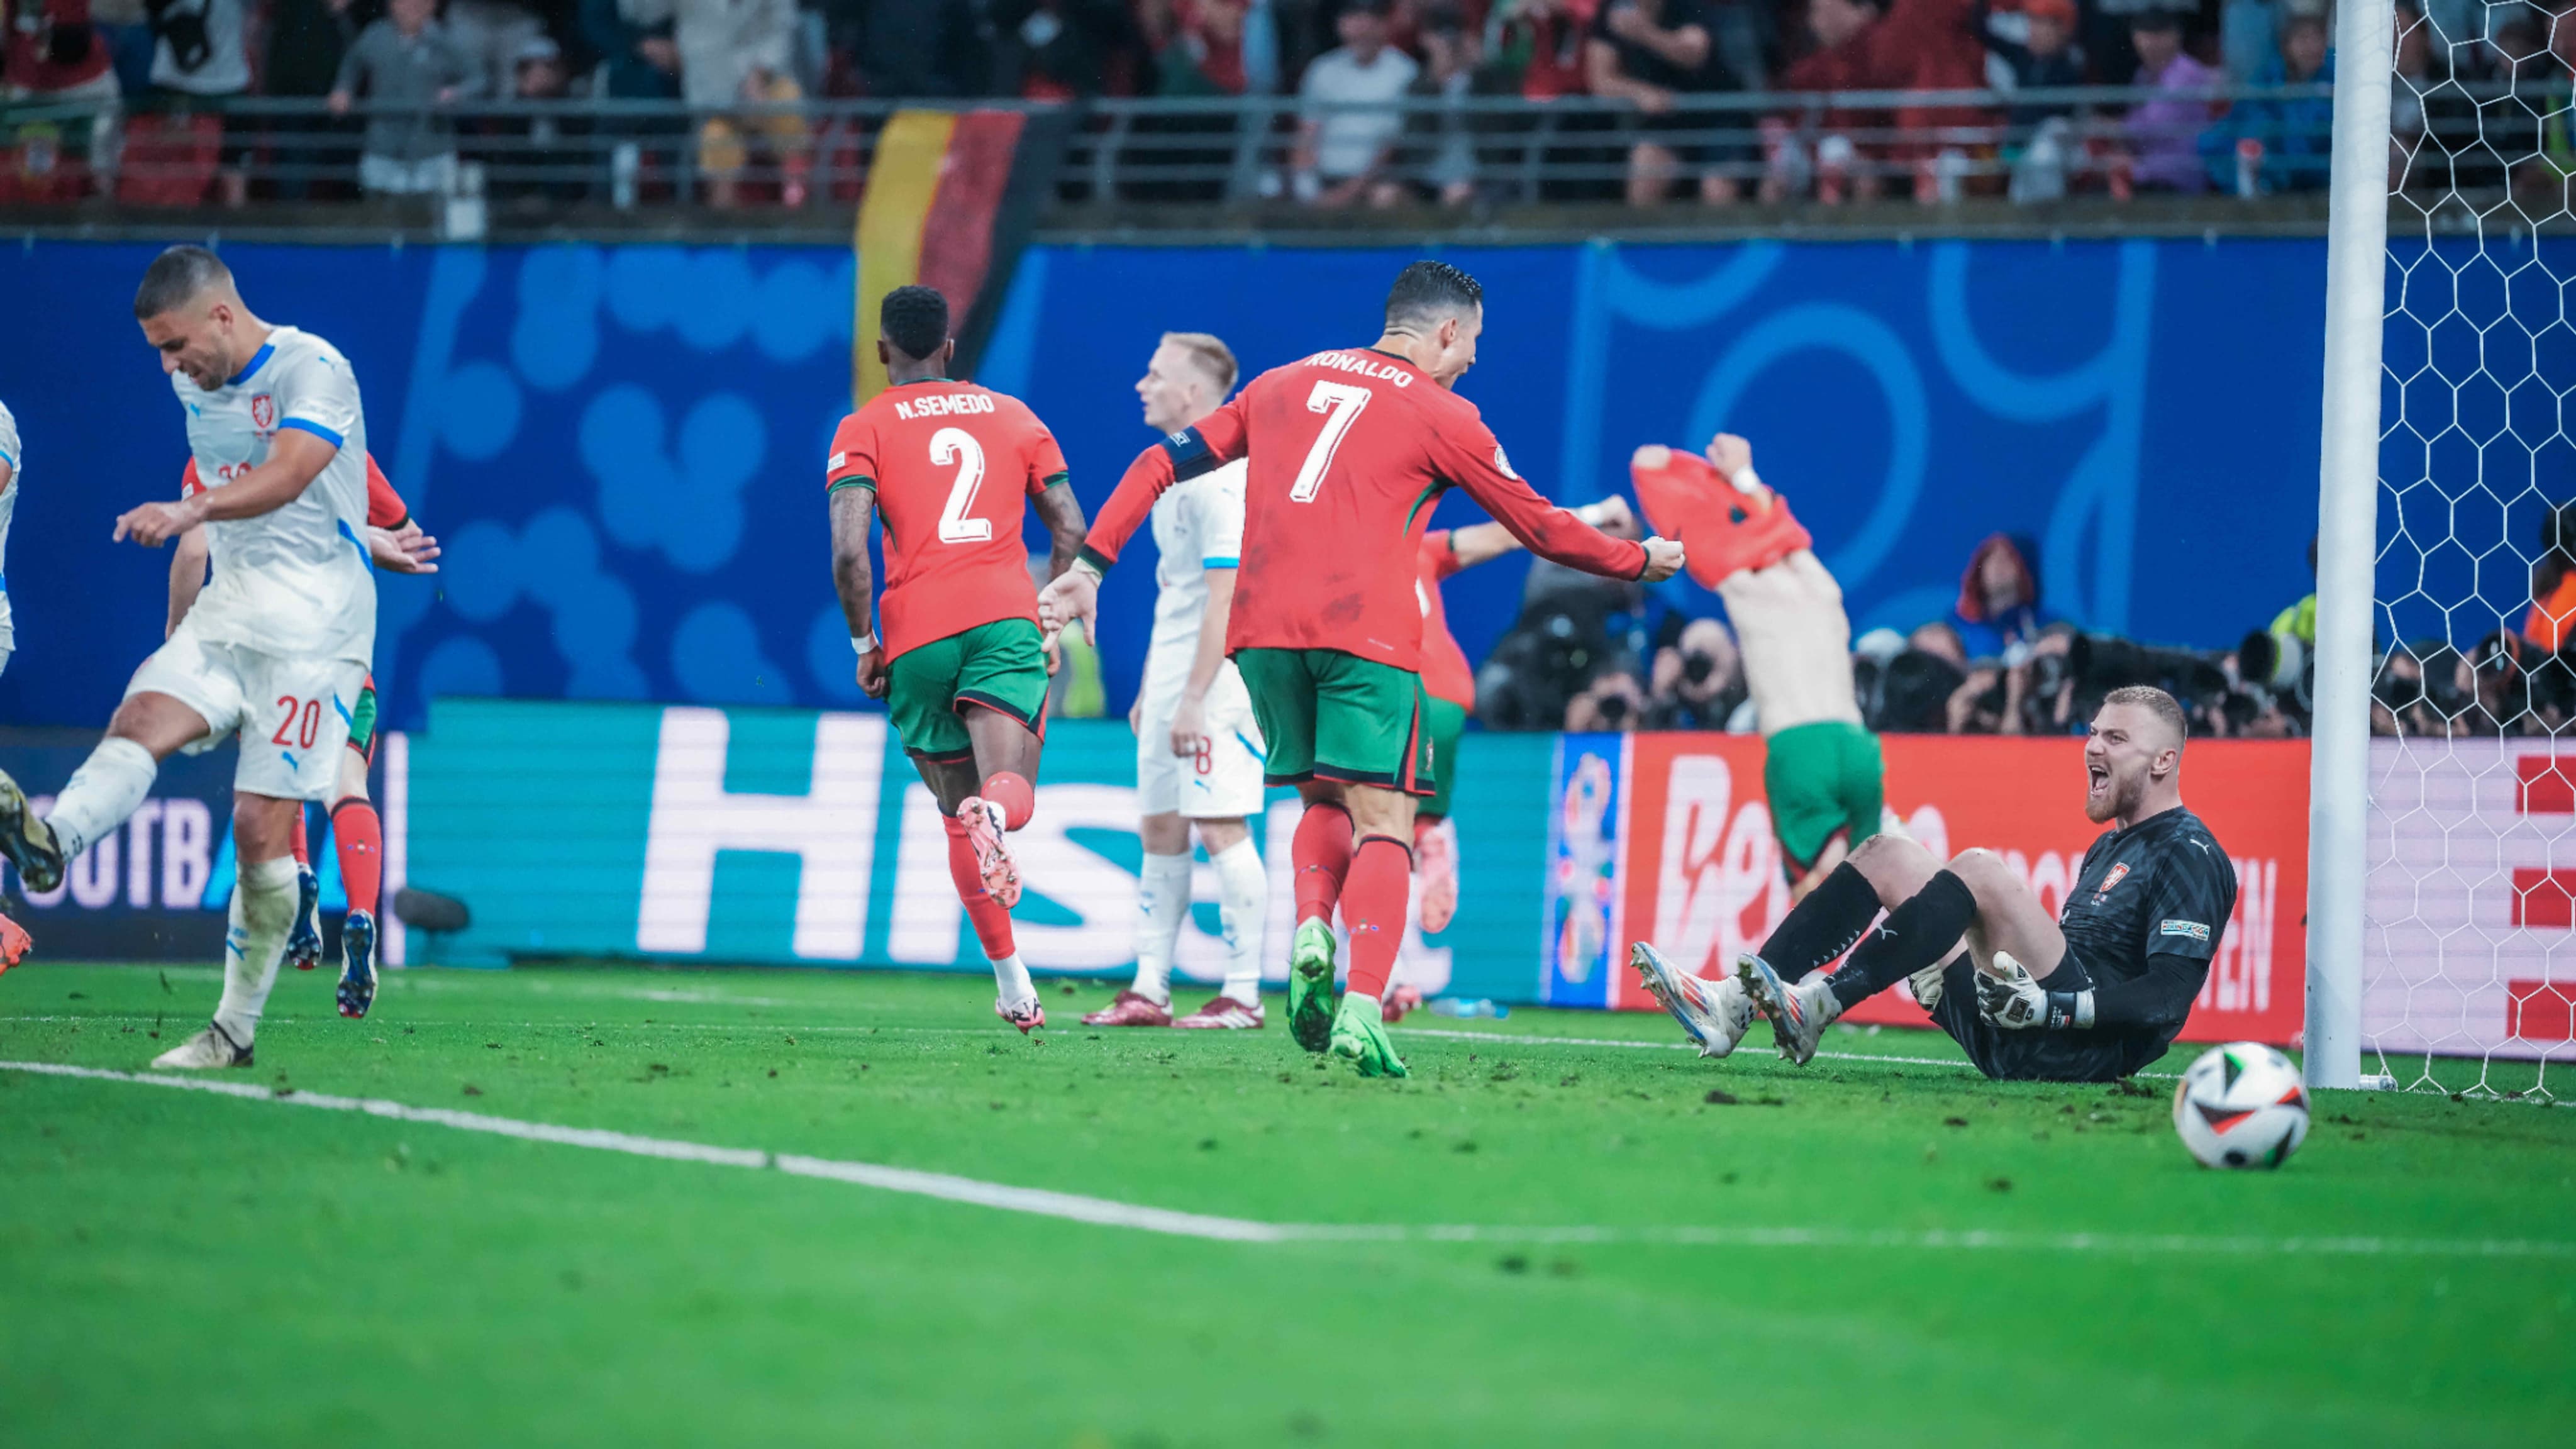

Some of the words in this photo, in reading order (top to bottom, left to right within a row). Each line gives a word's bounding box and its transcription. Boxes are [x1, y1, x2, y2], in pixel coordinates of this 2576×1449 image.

[1305, 351, 1414, 388] RONALDO
[894, 393, 995, 421] N.SEMEDO
[1289, 380, 1372, 502] 7
[929, 427, 992, 544] 2
[271, 694, 321, 750] 20
